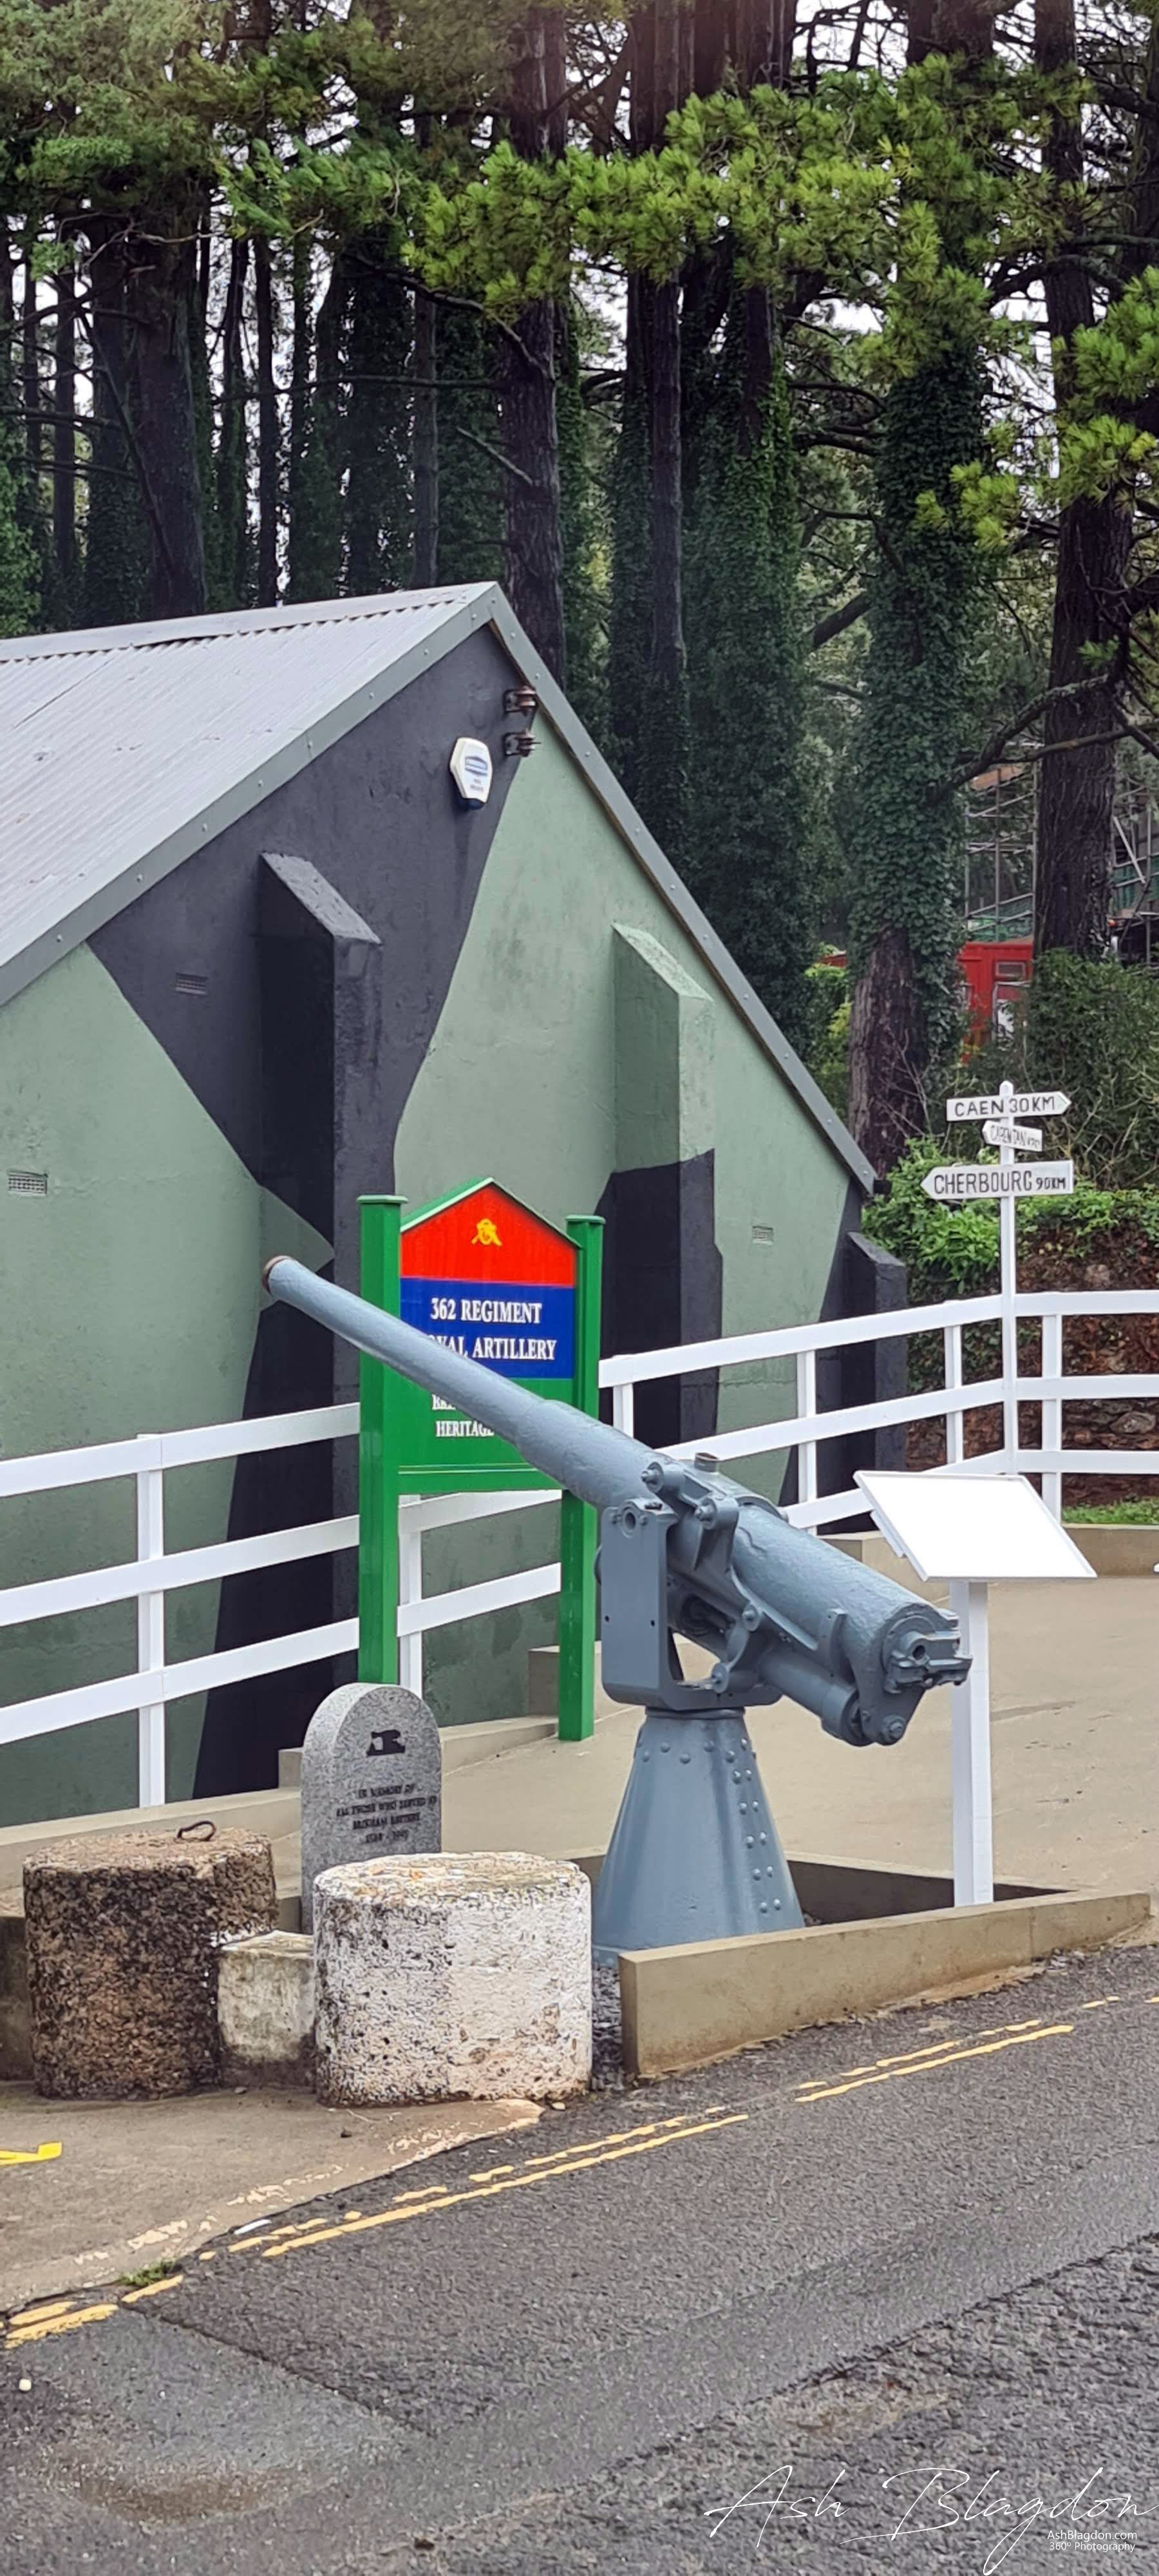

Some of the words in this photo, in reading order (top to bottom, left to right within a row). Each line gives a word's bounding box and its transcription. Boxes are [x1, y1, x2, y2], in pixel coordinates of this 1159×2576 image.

[955, 1099, 1004, 1117] CAEN
[934, 1170, 1032, 1195] CHERBOURG
[1035, 1177, 1066, 1190] 90KM
[431, 1298, 456, 1320] 362
[460, 1300, 542, 1323] REGIMENT
[472, 1338, 556, 1360] ARTILLERY
